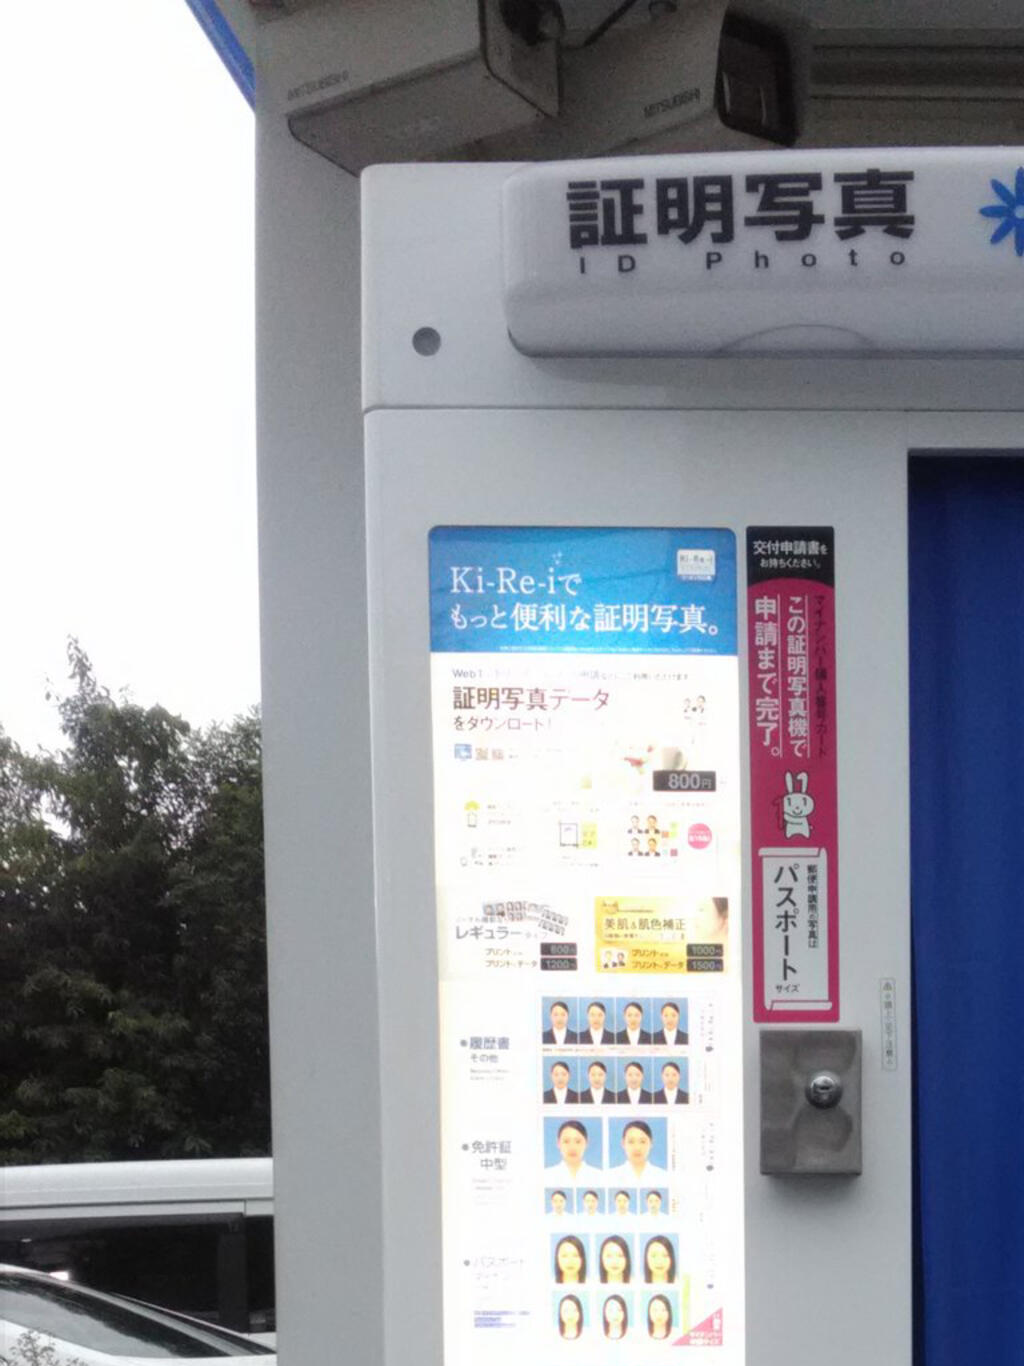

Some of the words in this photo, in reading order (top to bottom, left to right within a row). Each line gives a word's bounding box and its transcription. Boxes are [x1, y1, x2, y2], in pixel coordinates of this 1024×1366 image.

[566, 168, 916, 250] 証明写真
[579, 253, 636, 275] ID
[705, 248, 907, 272] Photo
[753, 541, 828, 555] 交付申請書を
[450, 602, 719, 636] もっと便利な証明写真。
[754, 596, 781, 757] 申請まで完了。
[787, 596, 808, 758] この証明写真機で
[452, 686, 609, 712] 証明写真データ
[668, 773, 712, 789] 800円
[774, 863, 801, 982] パスポート
[776, 983, 800, 993] サイズ
